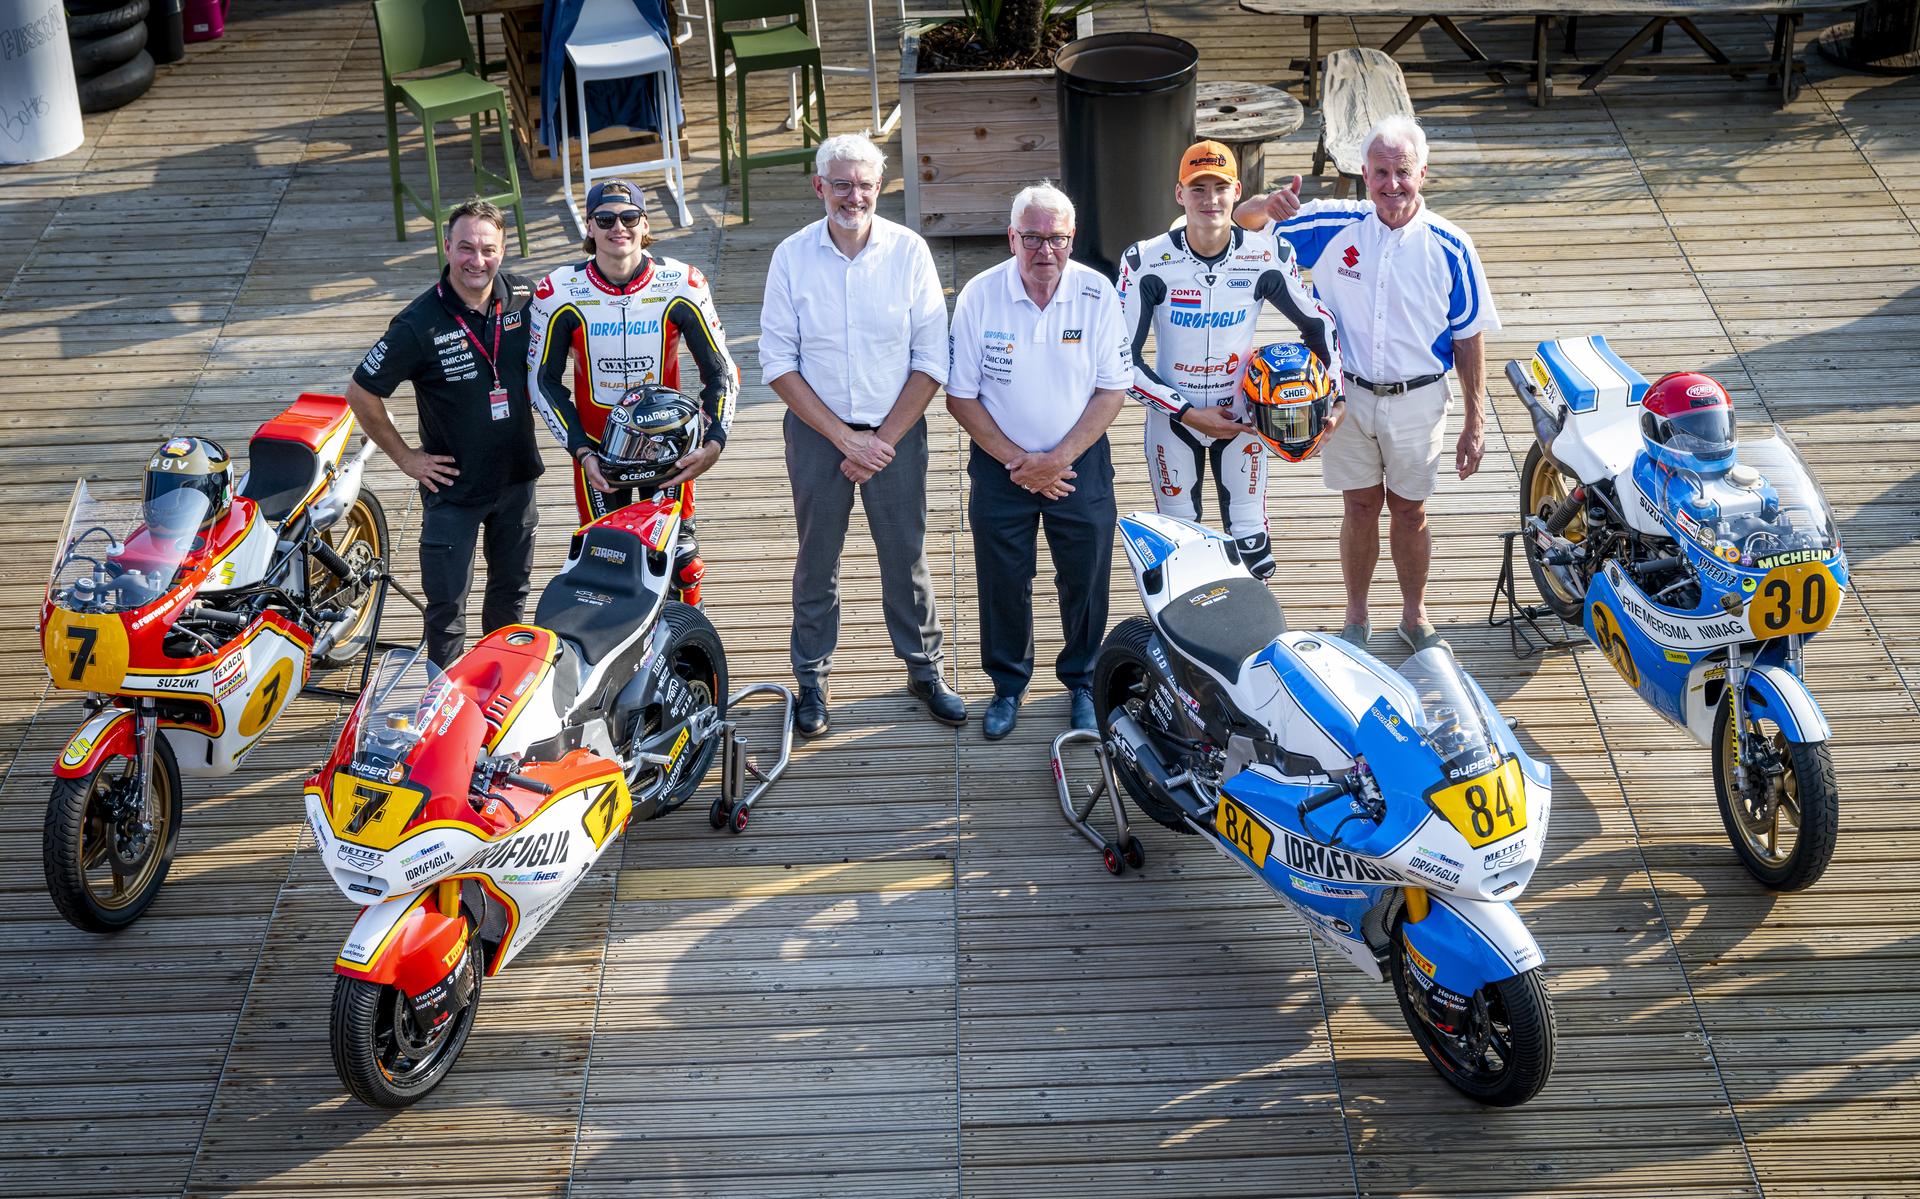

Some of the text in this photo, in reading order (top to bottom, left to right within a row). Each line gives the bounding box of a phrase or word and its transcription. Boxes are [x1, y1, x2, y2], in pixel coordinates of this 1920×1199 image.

[603, 359, 649, 371] WANTY
[1173, 362, 1225, 374] SUPER
[1187, 380, 1235, 391] Heisterkamp
[1283, 388, 1308, 399] SHOEI
[150, 459, 189, 471] agv
[629, 470, 656, 480] CERCO
[1248, 455, 1262, 495] SUPER
[1696, 556, 1728, 584] SPEED
[1755, 548, 1834, 569] MICHELIN
[139, 599, 174, 628] FORWARD
[1763, 573, 1826, 631] 30
[1621, 595, 1745, 642] RIEMERSMA NIMAG
[66, 625, 99, 682] 7
[213, 652, 243, 681] TEXACO
[156, 678, 199, 690] SUZUKI
[218, 671, 243, 694] HERON
[258, 671, 282, 728] 7
[350, 760, 388, 778] SUPER
[658, 756, 686, 802] TRIUMPH
[1449, 755, 1494, 780] SUPER
[342, 783, 393, 836] 7
[599, 784, 620, 843] 7
[1464, 776, 1515, 839] 84
[1224, 802, 1256, 860] 84
[338, 844, 385, 860] METTET
[1484, 839, 1526, 862] METTET
[415, 985, 442, 1003] Henko
[1437, 988, 1466, 1004] Henko
